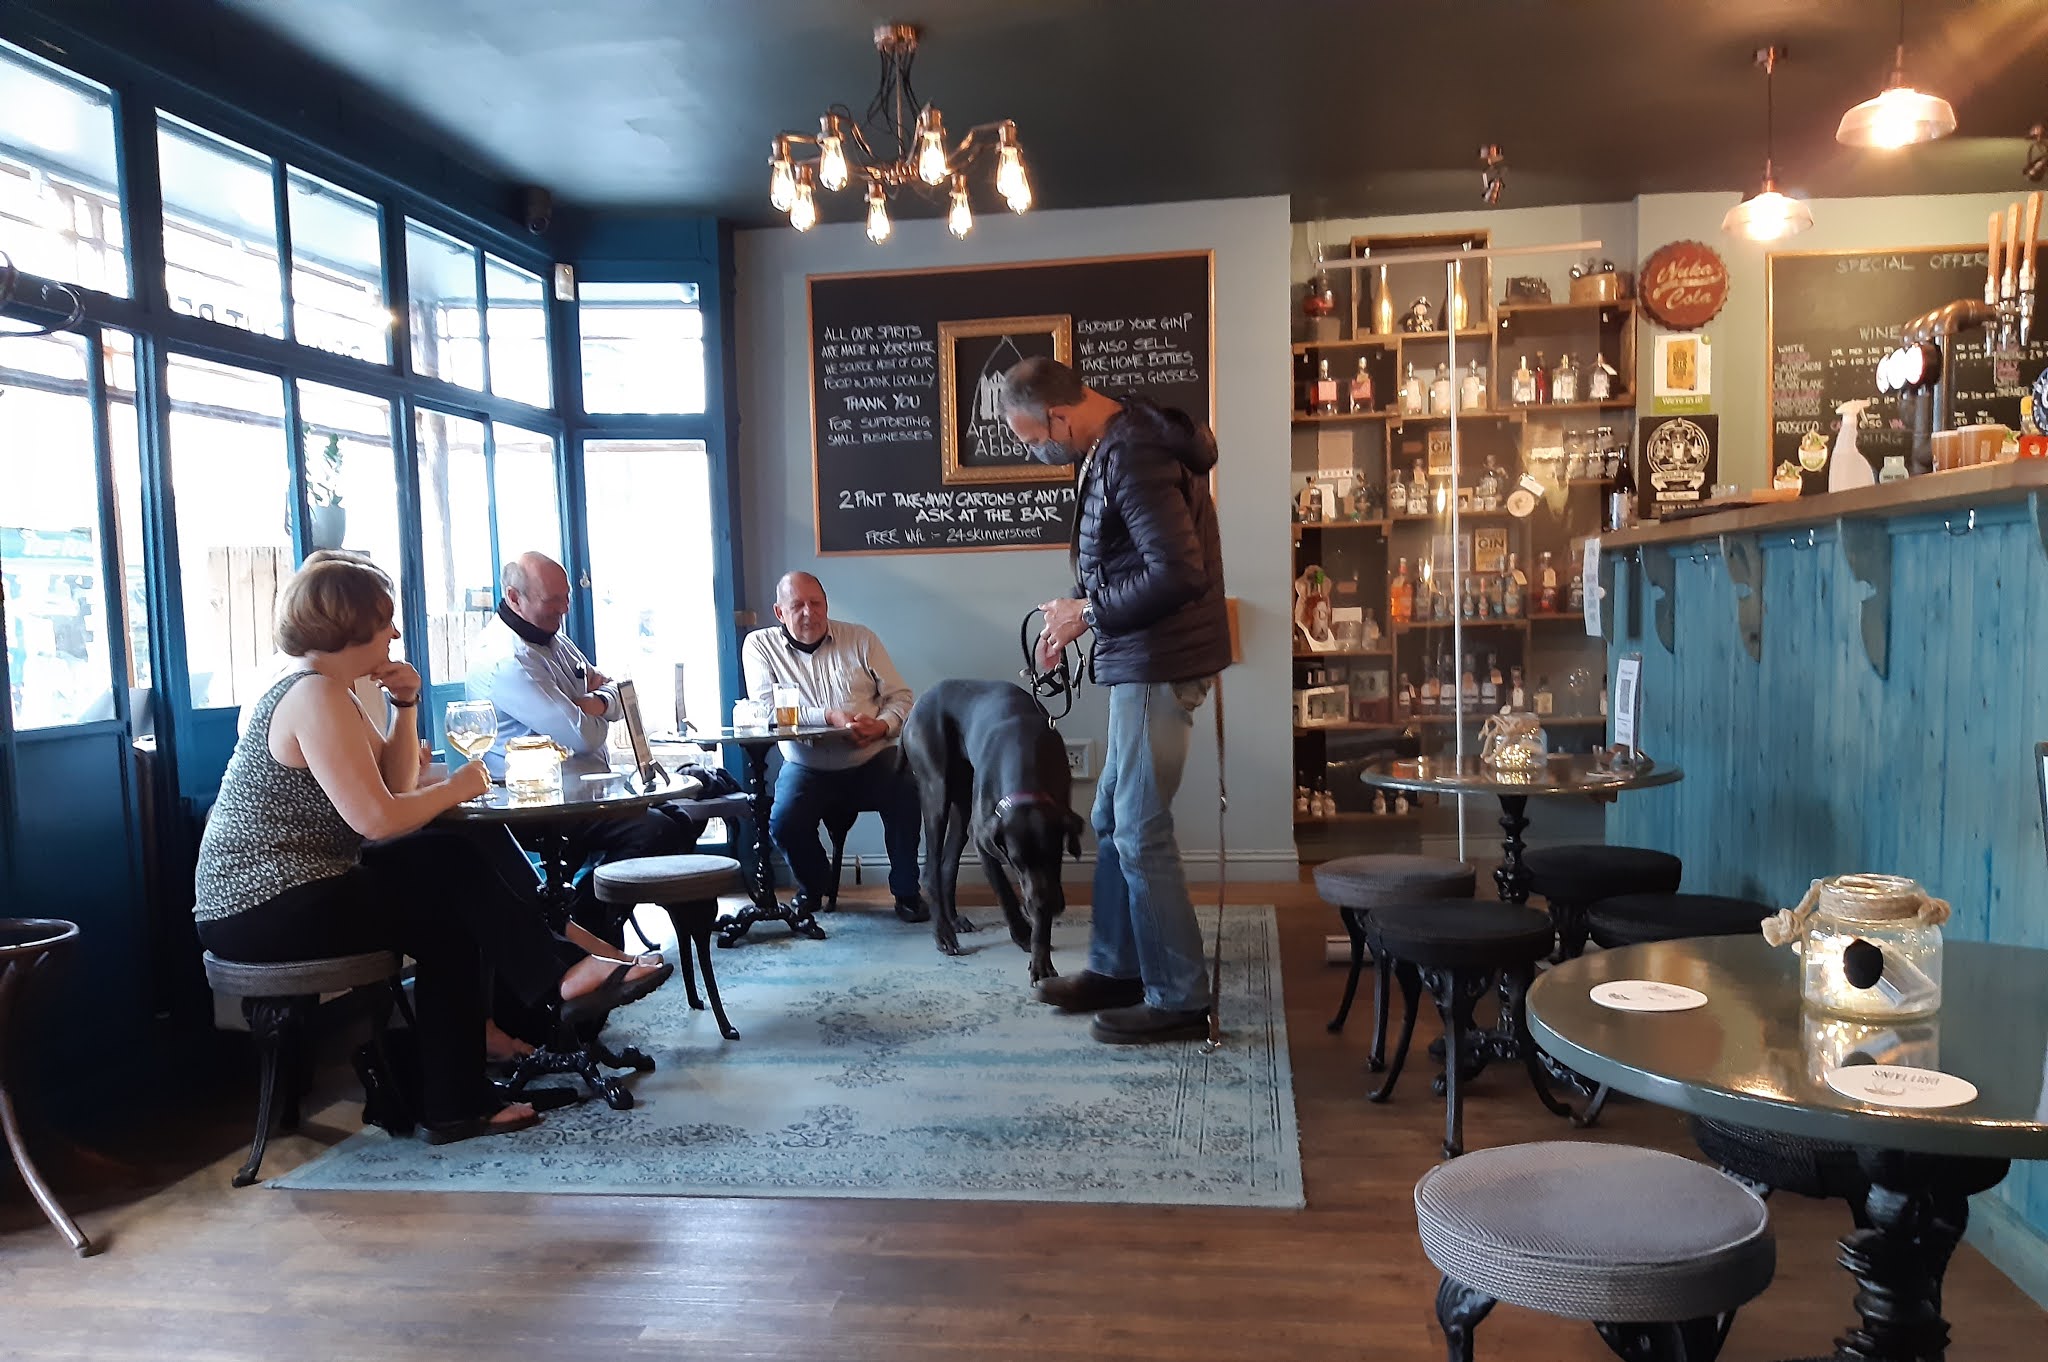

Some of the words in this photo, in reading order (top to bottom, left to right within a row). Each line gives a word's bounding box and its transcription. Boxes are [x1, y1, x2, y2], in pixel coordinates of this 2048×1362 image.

[1656, 256, 1713, 284] Nuka
[1836, 255, 1915, 274] SPECIAL
[1929, 252, 1988, 270] OFFER
[1666, 287, 1711, 310] Cola
[824, 326, 849, 341] ALL
[851, 325, 874, 342] OUR
[877, 324, 922, 339] SPIRITS
[1077, 318, 1124, 335] ENJOYED
[1128, 317, 1157, 332] YOUR
[821, 344, 839, 359] ARE
[840, 343, 866, 357] MADE
[869, 343, 880, 355] IN
[881, 340, 936, 356] YORKSHIRE
[1079, 338, 1095, 356] WE
[1098, 339, 1128, 354] ALSO
[1133, 336, 1178, 351] SELL
[1776, 344, 1805, 354] WHITE
[824, 361, 838, 376] WE
[910, 356, 934, 370] OUR
[823, 375, 852, 390] FOOD
[893, 372, 936, 389] LOCALLY
[1148, 368, 1199, 384] GLASSES
[843, 395, 887, 412] THANK
[892, 392, 920, 411] YOU
[828, 415, 852, 431] FOR
[860, 415, 932, 429] SUPPORTING
[827, 433, 859, 447] SMALL
[862, 430, 933, 444] BUSINESSES
[974, 437, 1032, 461] Abbey
[839, 490, 854, 510] 2
[854, 490, 886, 508] PINT
[955, 491, 1015, 507] CARTONS
[1017, 490, 1033, 504] OF
[1034, 488, 1059, 505] ANY
[915, 508, 955, 524] ASK
[958, 508, 978, 523] AT
[984, 508, 1013, 523] THE
[1020, 506, 1062, 522] BAR
[865, 528, 900, 545] FREE
[1478, 538, 1504, 550] GIN
